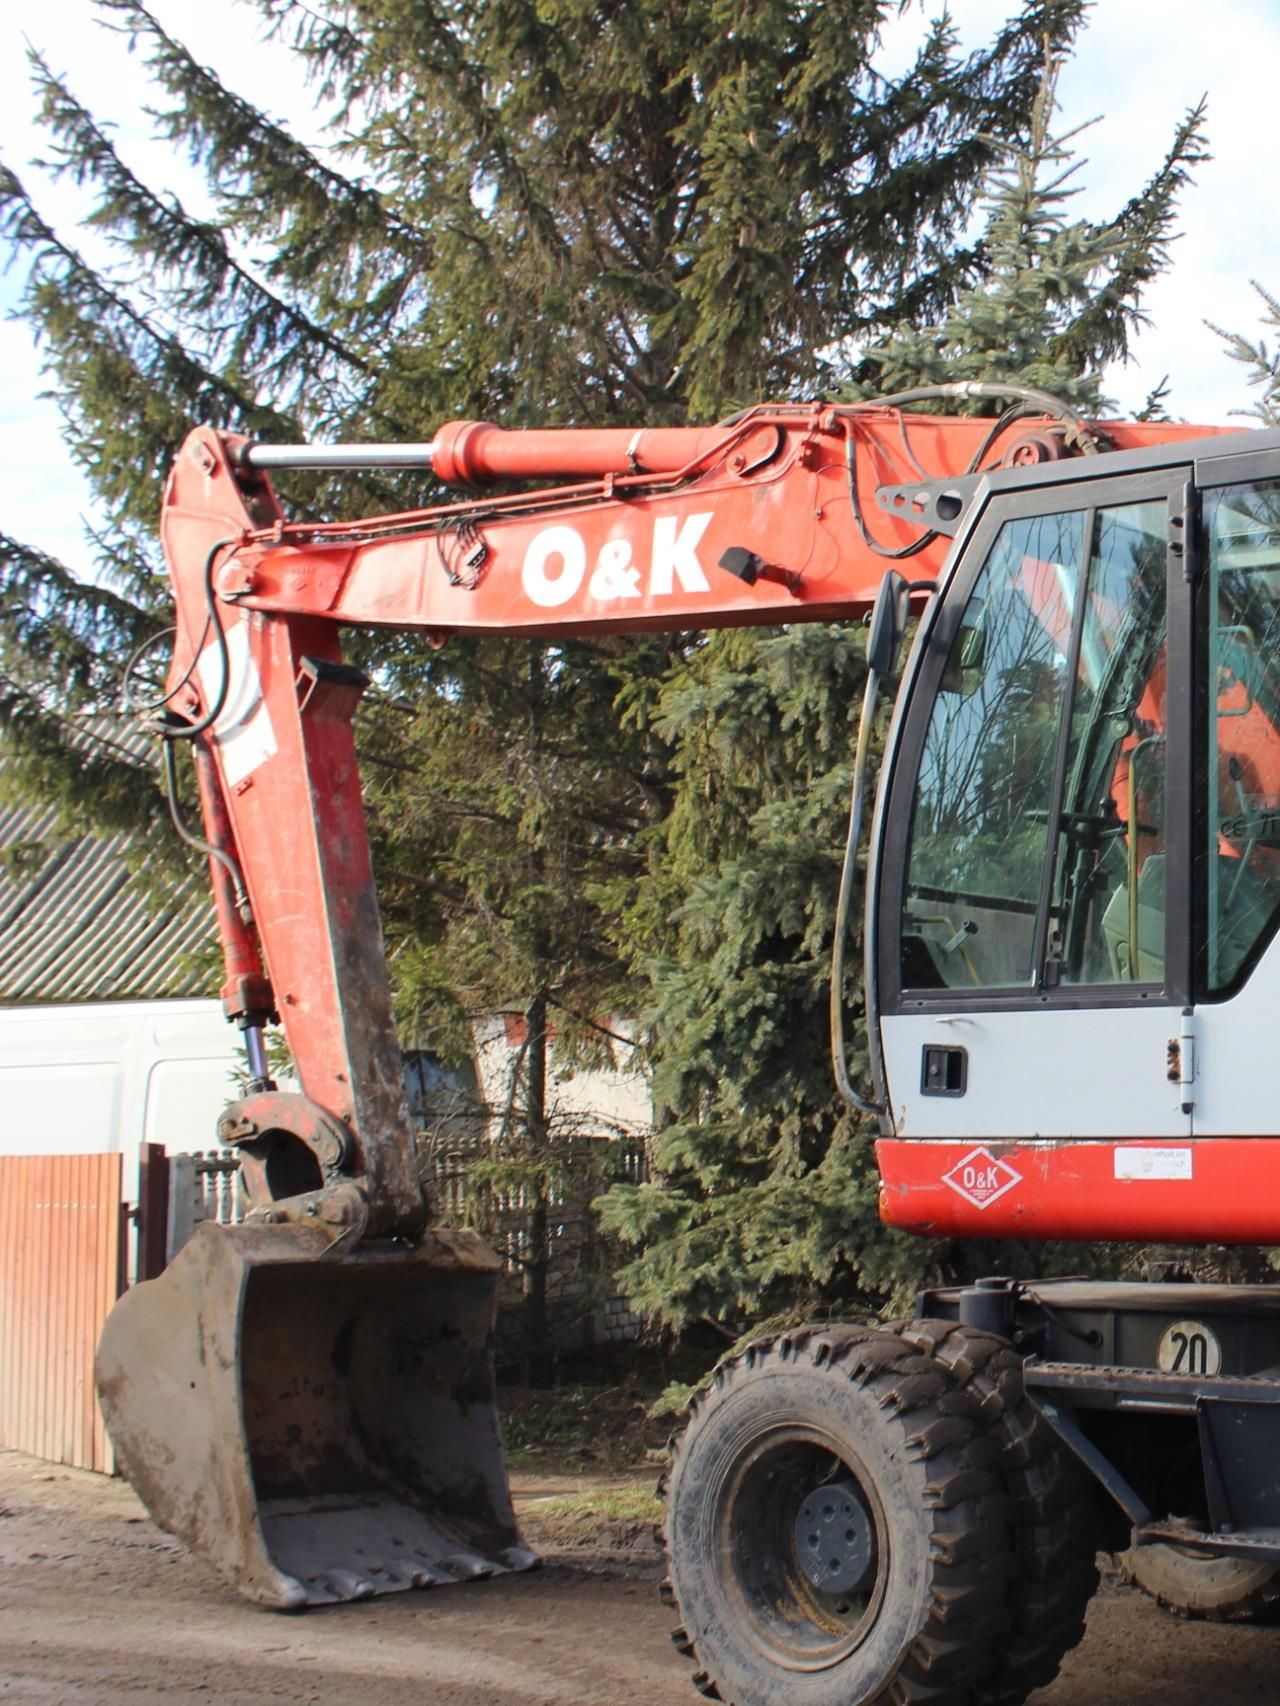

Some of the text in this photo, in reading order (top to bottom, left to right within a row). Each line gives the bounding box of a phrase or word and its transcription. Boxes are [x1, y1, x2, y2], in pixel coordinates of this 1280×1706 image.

[521, 512, 714, 607] O&K
[1260, 812, 1277, 834] 71
[963, 1166, 999, 1189] O&K
[1170, 1332, 1207, 1374] 20
